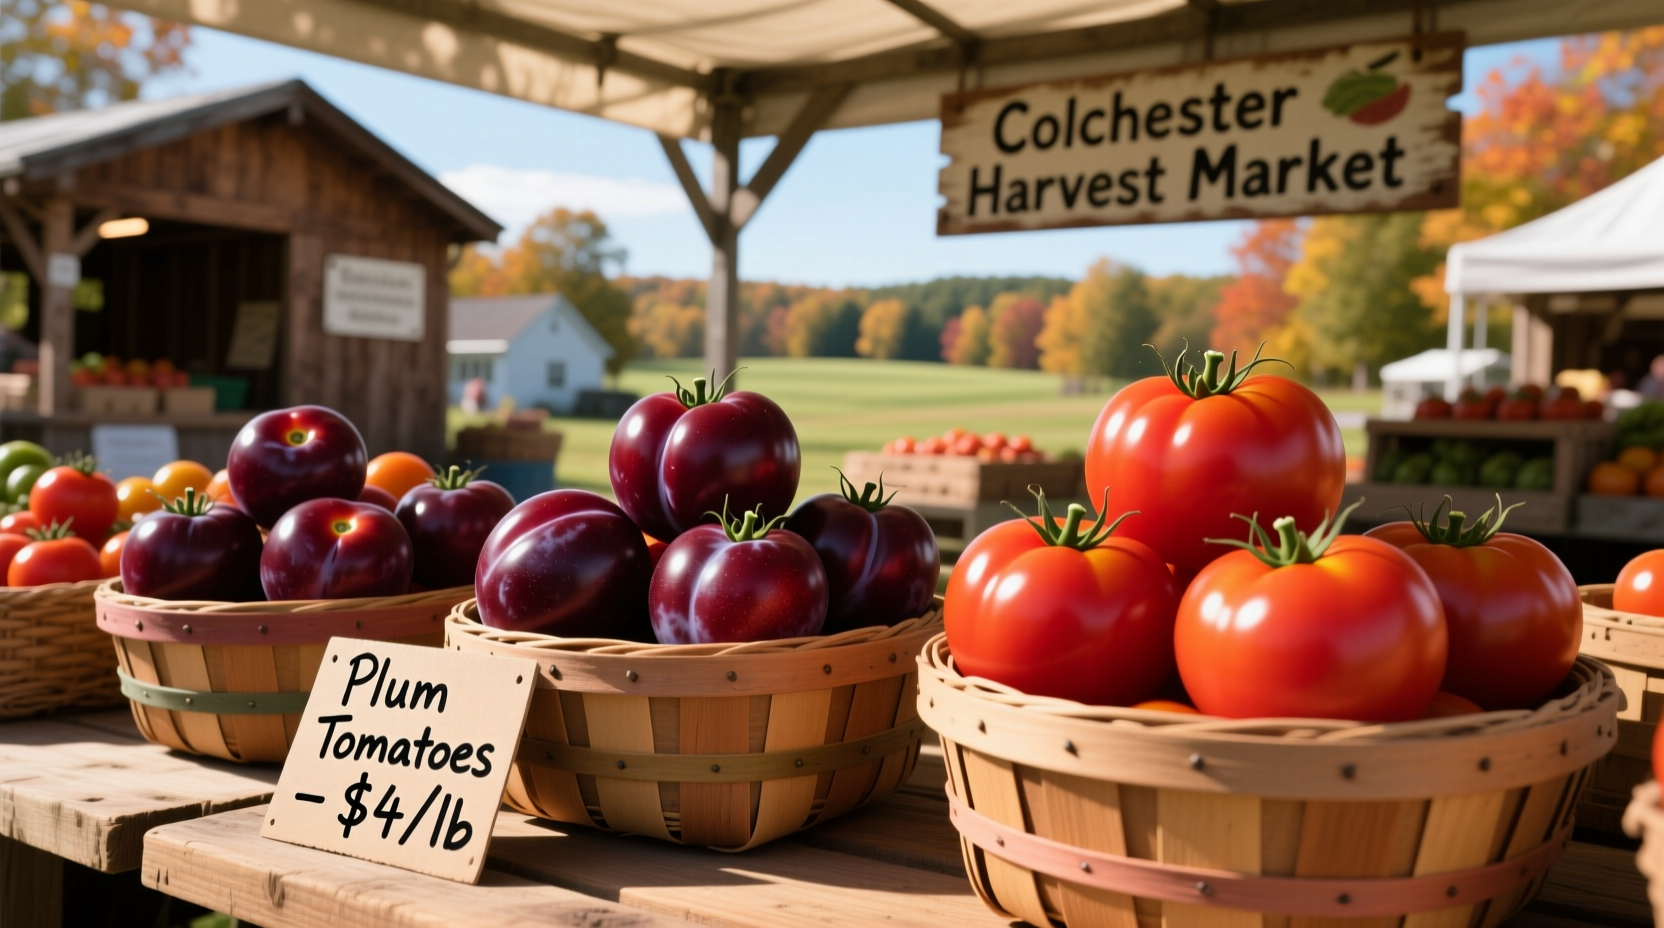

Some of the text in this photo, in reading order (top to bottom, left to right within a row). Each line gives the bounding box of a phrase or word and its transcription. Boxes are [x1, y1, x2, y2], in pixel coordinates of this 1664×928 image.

[993, 82, 1298, 154] Colchester
[967, 136, 1406, 217] Harvest Market
[341, 652, 448, 713] Plum
[318, 714, 495, 778] Tomatoes
[337, 772, 473, 851] $4/lb
